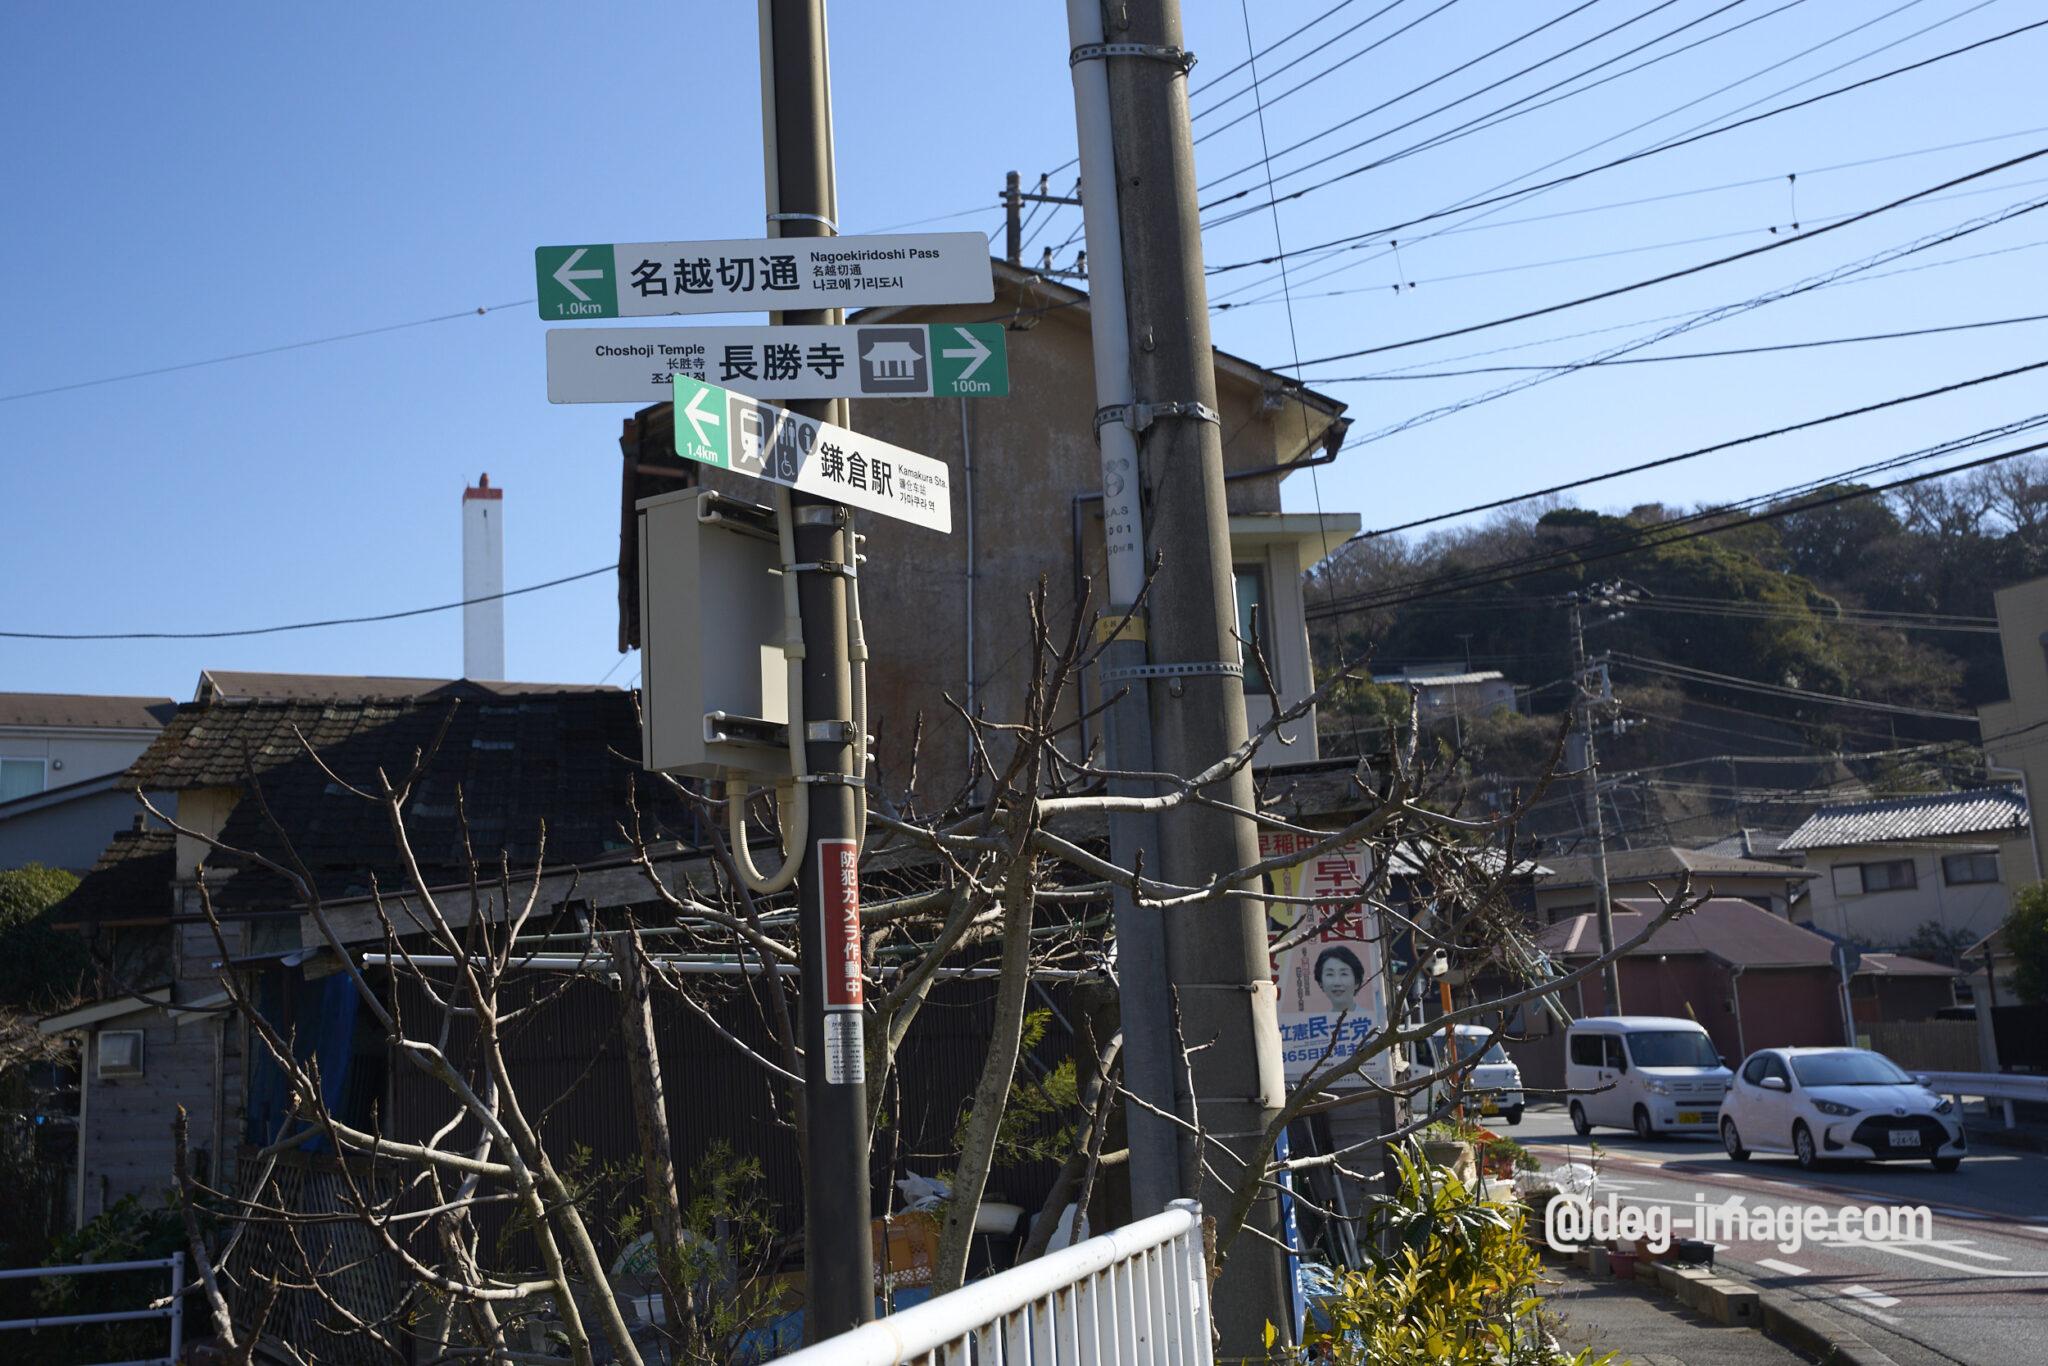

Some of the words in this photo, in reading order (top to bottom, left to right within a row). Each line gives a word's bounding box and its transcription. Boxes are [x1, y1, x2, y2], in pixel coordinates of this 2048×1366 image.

[810, 249, 906, 263] Nagoekiridoshi
[909, 248, 940, 259] Pass
[631, 255, 800, 298] 名越切通
[812, 264, 862, 276] 名越切通
[813, 279, 851, 291] 나코에
[854, 276, 904, 290] 기리도시
[557, 302, 602, 315] 1.0km
[595, 345, 654, 359] Choshoji
[658, 344, 706, 357] Temple
[666, 358, 706, 370] 长胜寺
[719, 342, 845, 382] 長勝寺
[951, 380, 991, 393] 100m
[687, 442, 719, 463] 1.4km
[821, 441, 894, 499] 鎌倉駅
[899, 464, 933, 485] Kamakura
[934, 475, 948, 489] Sta.
[840, 851, 861, 998] 防犯カメラ作動中
[1279, 1016, 1372, 1041] 立憲民主党
